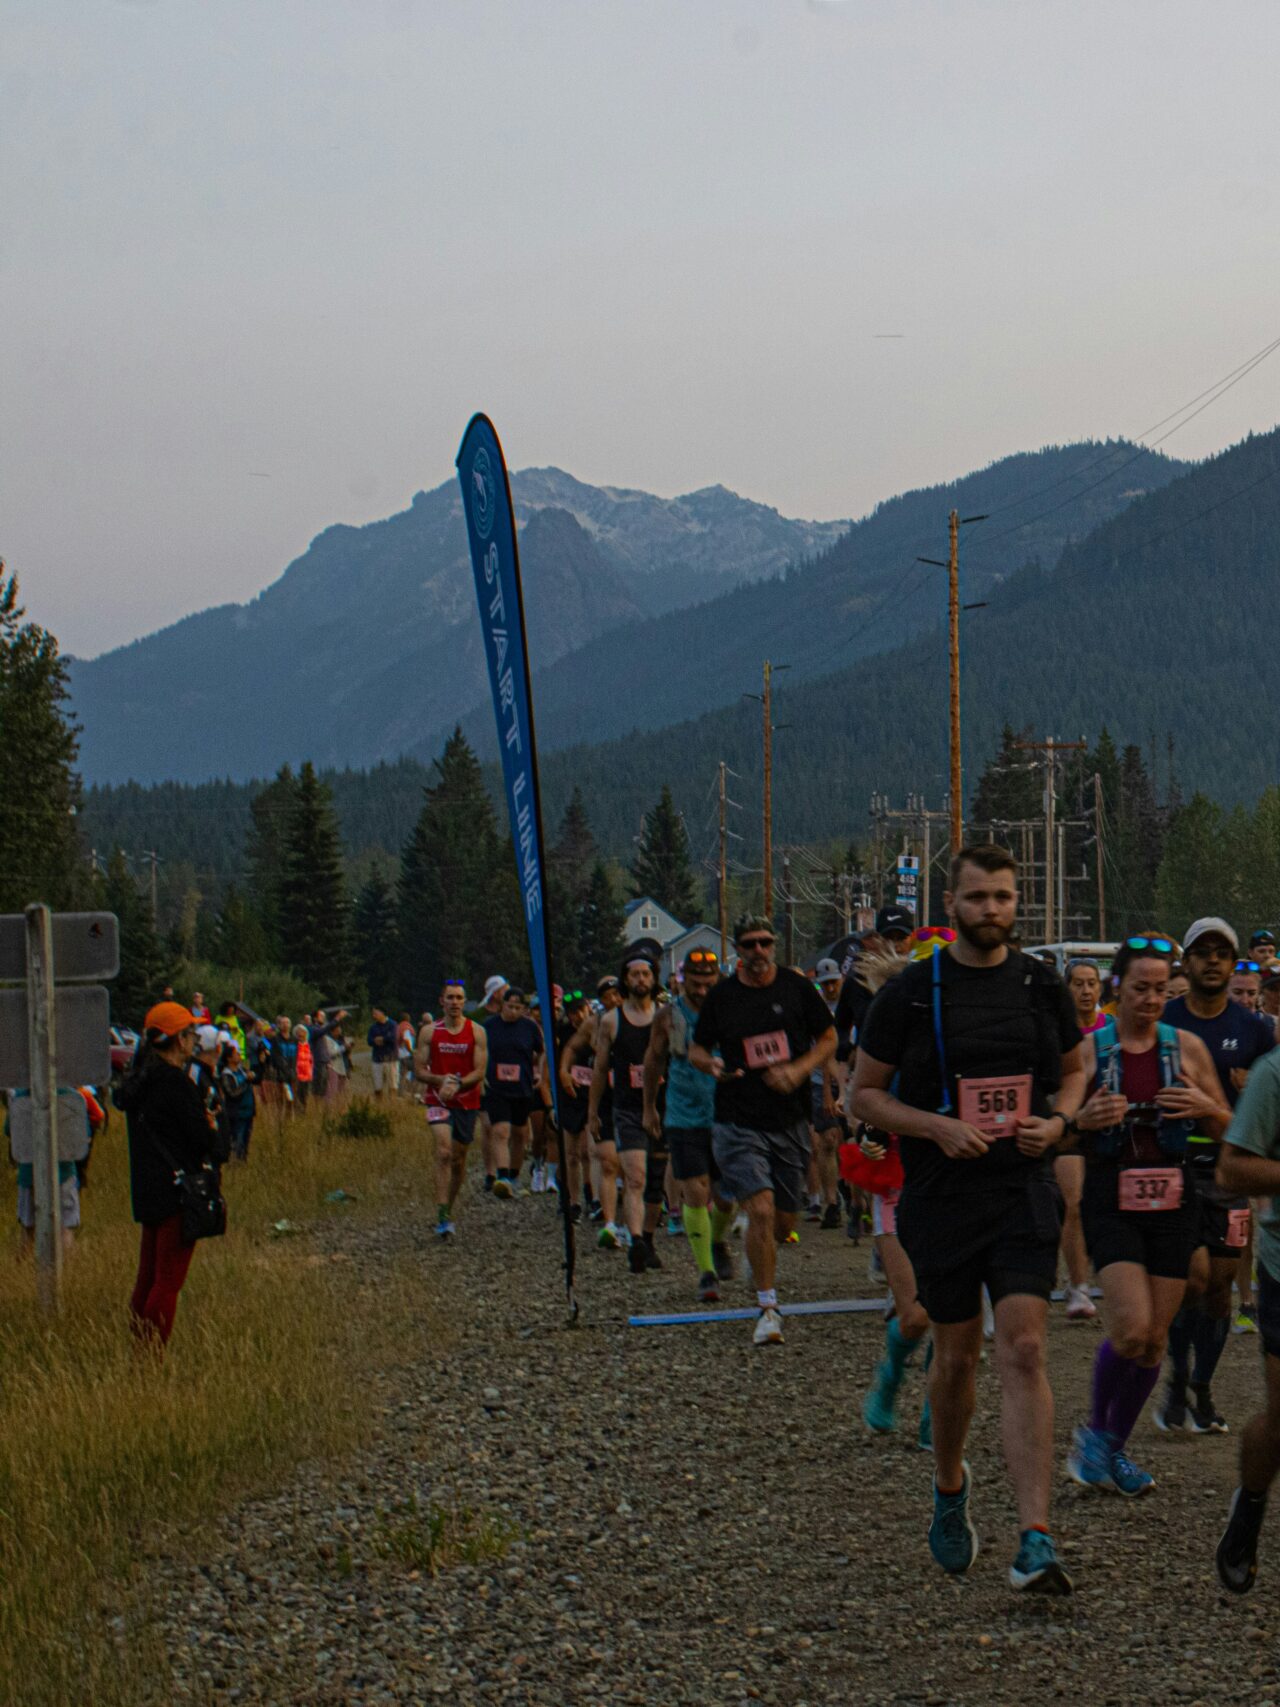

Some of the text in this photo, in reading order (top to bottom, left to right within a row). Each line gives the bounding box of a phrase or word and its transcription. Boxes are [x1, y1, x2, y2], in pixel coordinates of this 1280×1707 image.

[483, 541, 522, 754] START
[512, 771, 542, 923] LINE
[978, 1088, 1018, 1114] 568
[1135, 1179, 1169, 1199] 337
